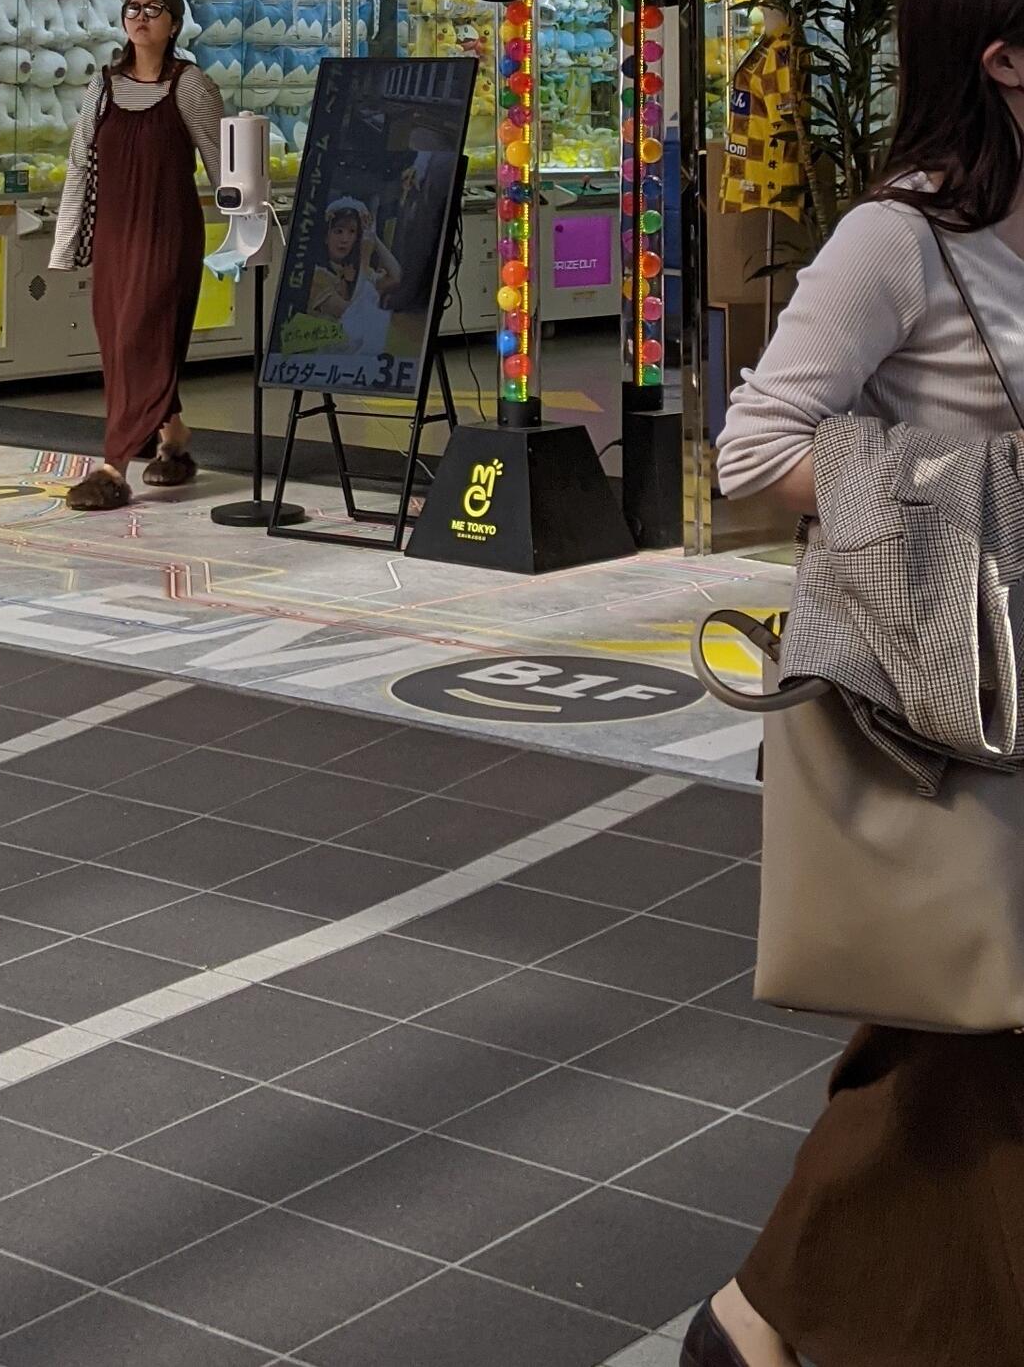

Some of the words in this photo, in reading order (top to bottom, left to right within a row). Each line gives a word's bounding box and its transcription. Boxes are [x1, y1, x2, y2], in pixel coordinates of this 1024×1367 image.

[262, 361, 367, 387] パウダールーム
[371, 352, 415, 389] 3F
[451, 520, 465, 531] ME
[466, 521, 497, 536] TOKYO
[457, 660, 677, 702] B1F
